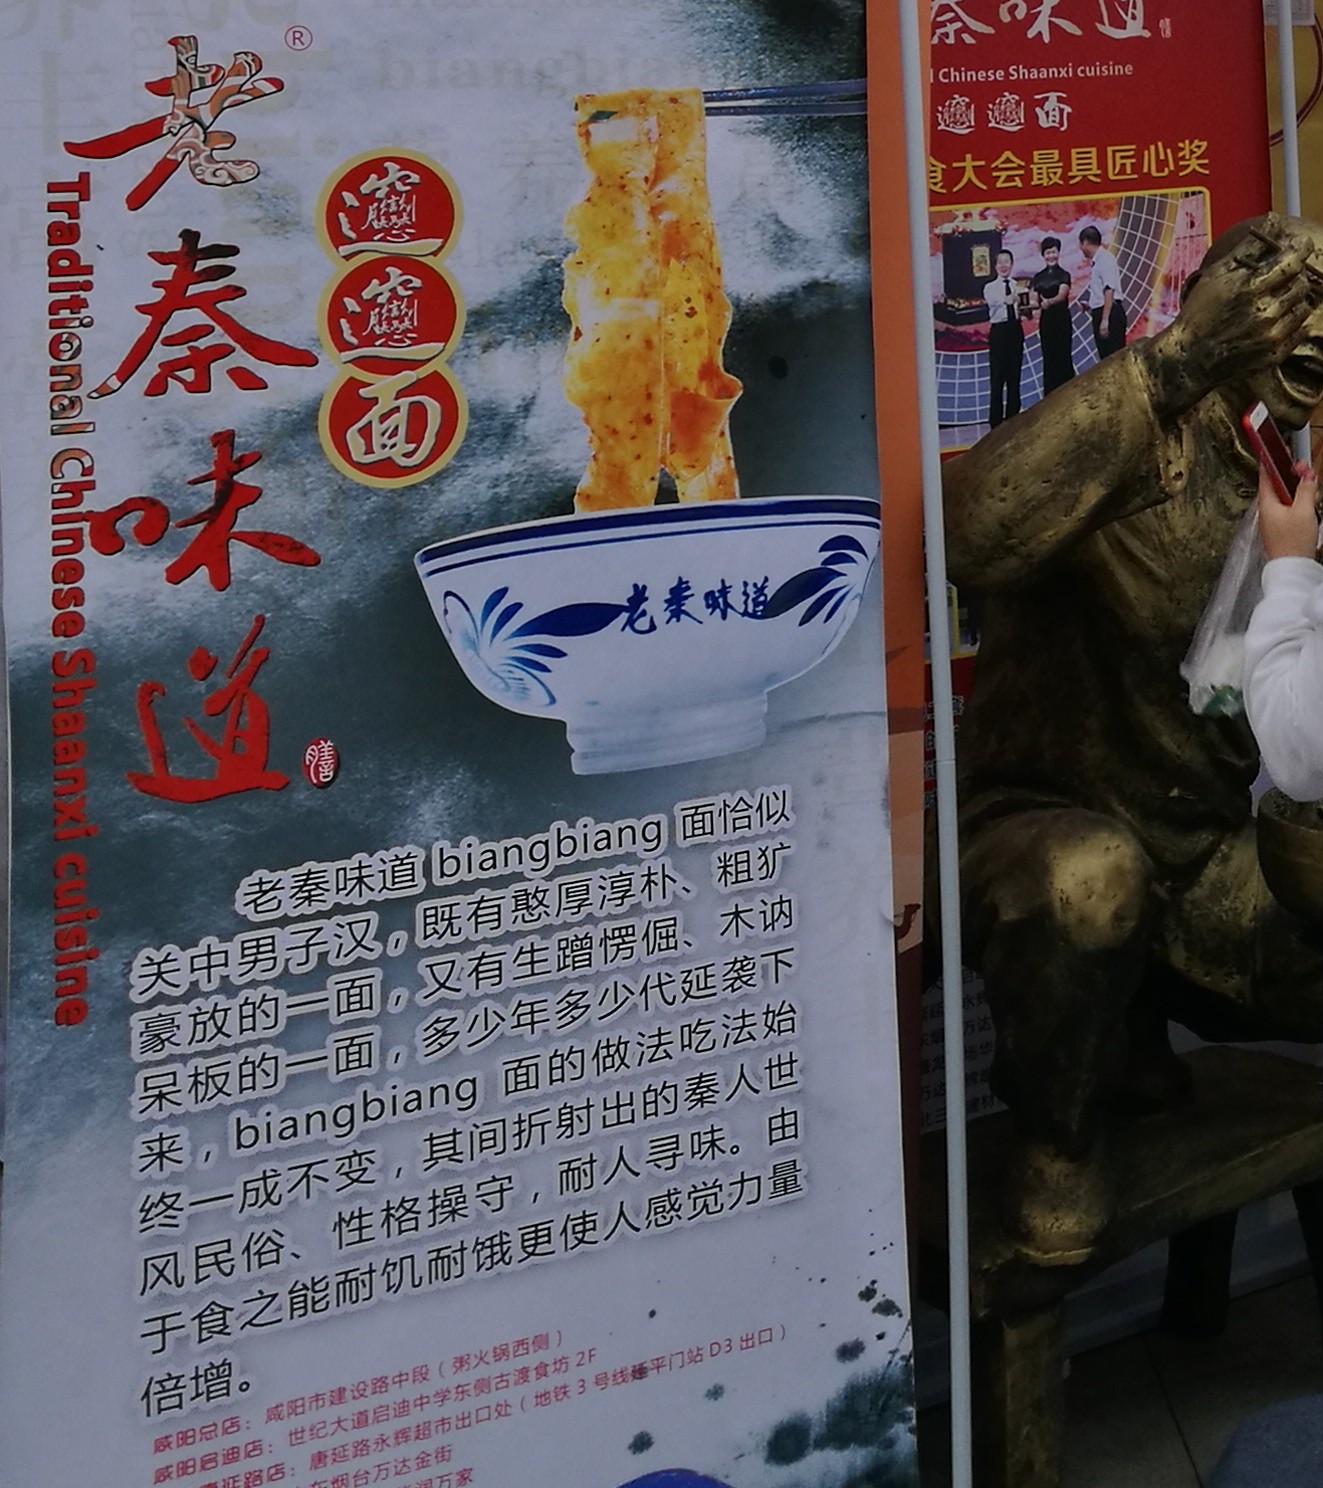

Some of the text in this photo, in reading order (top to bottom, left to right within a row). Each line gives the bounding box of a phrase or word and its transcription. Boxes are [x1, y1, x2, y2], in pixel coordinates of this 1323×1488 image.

[938, 66, 1005, 84] Chinese
[1008, 62, 1073, 81] Shaanxi
[1077, 60, 1134, 79] cuisine
[64, 35, 321, 804] 老秦味道
[45, 172, 99, 1028] Traditional Chinese Shaanxi cuisine
[619, 575, 771, 635] 老秦味道
[246, 791, 790, 915] 老秦味道 biangbiang 面恰似
[502, 1005, 798, 1095] 面的做法吃法始
[575, 1347, 597, 1368] 2F
[709, 1337, 733, 1358] D3
[140, 1358, 251, 1418] 倍增。
